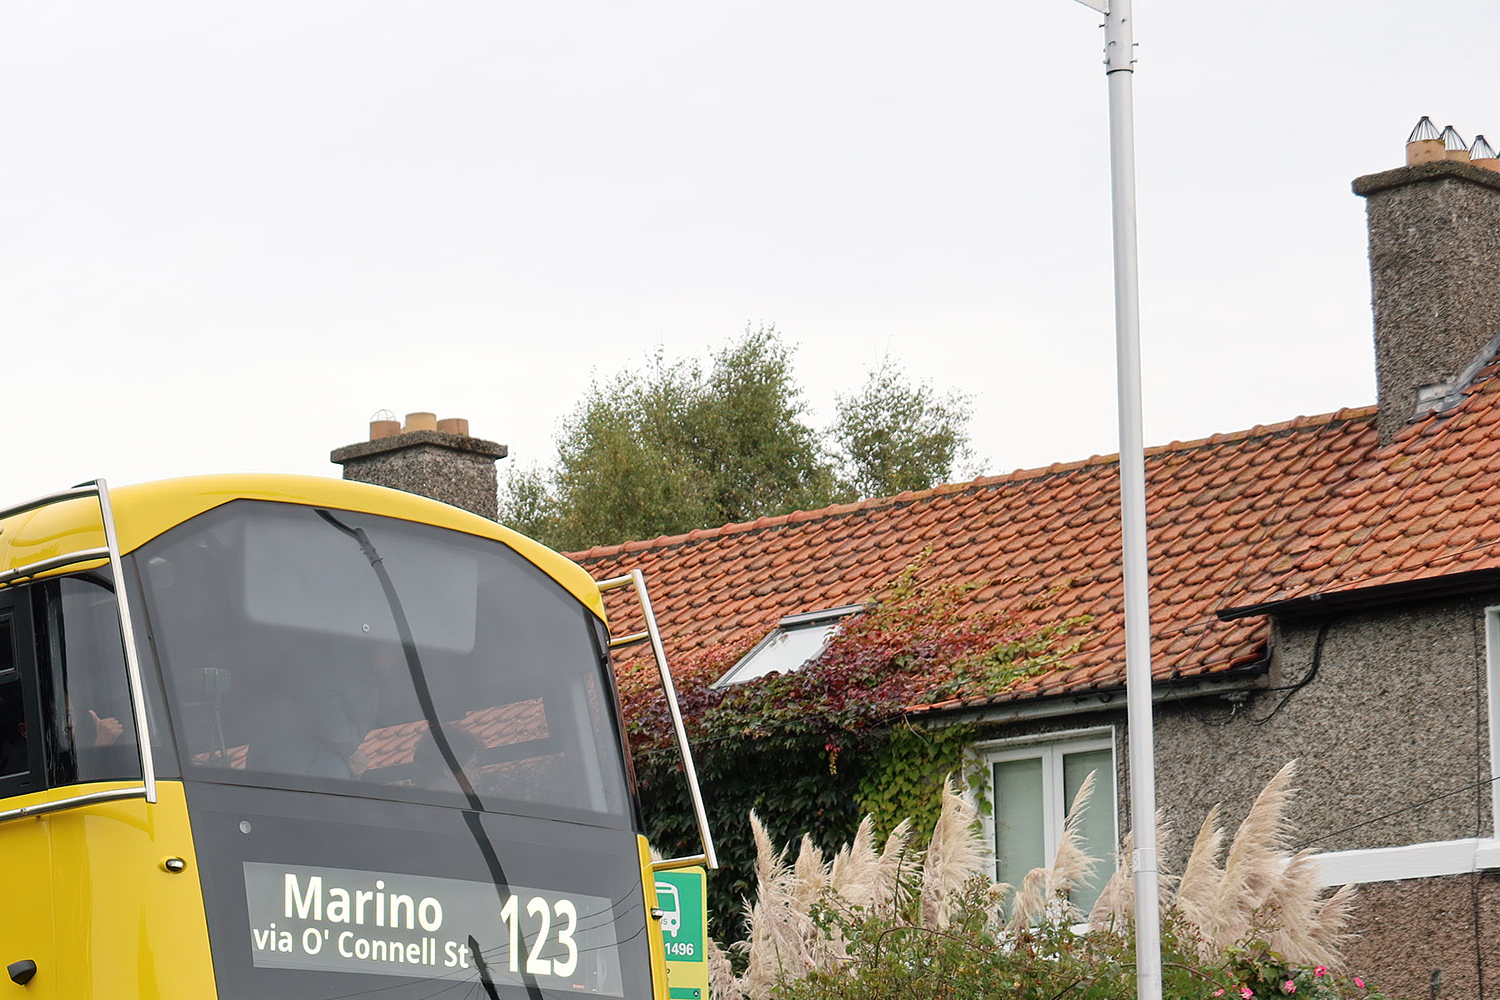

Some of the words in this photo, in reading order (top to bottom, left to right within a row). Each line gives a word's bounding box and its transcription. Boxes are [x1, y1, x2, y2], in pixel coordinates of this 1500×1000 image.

[284, 873, 443, 932] Marino
[253, 923, 293, 953] via
[302, 927, 330, 955] O'
[338, 930, 436, 966] Connell
[444, 940, 470, 969] St
[500, 894, 579, 978] 123
[665, 942, 694, 956] 1496
